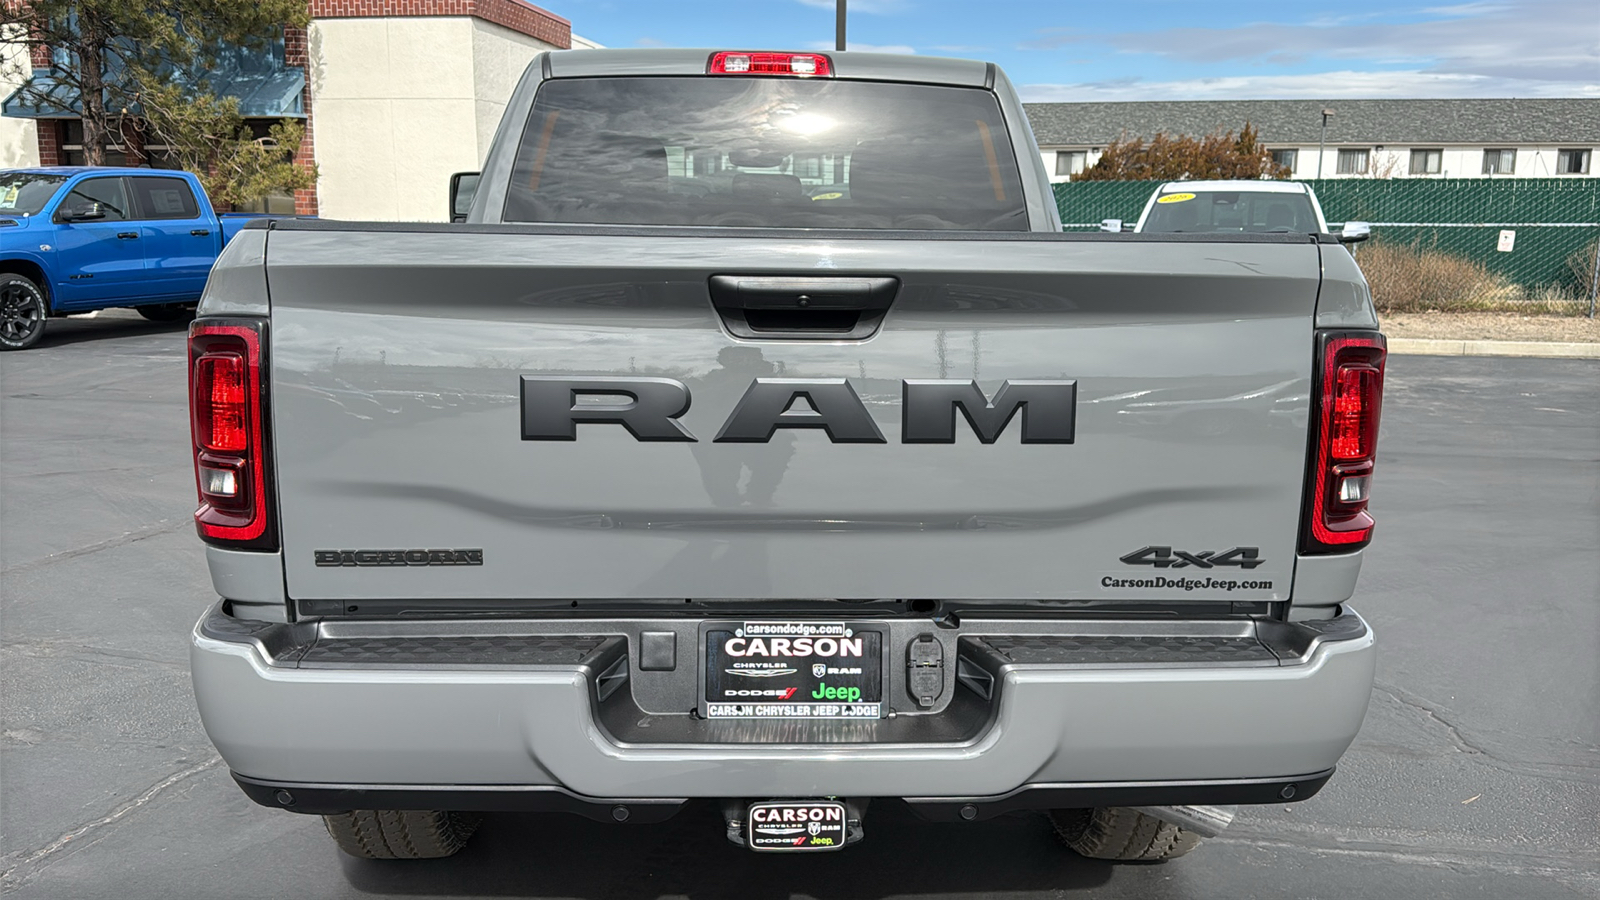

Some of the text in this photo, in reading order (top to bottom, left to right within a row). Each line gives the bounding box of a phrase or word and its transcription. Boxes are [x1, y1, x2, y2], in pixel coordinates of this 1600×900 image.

[520, 374, 1077, 444] RAM
[314, 549, 483, 567] BIGHORN
[1119, 545, 1267, 569] 4x4
[1101, 576, 1273, 591] CarsonDodgeJeep.com
[746, 624, 843, 636] carsondodge.com
[725, 638, 862, 656] CARSON
[812, 682, 861, 703] Jeep
[755, 705, 811, 716] CHRYSLER
[812, 705, 840, 716] JEEP
[753, 808, 840, 821] CARSON
